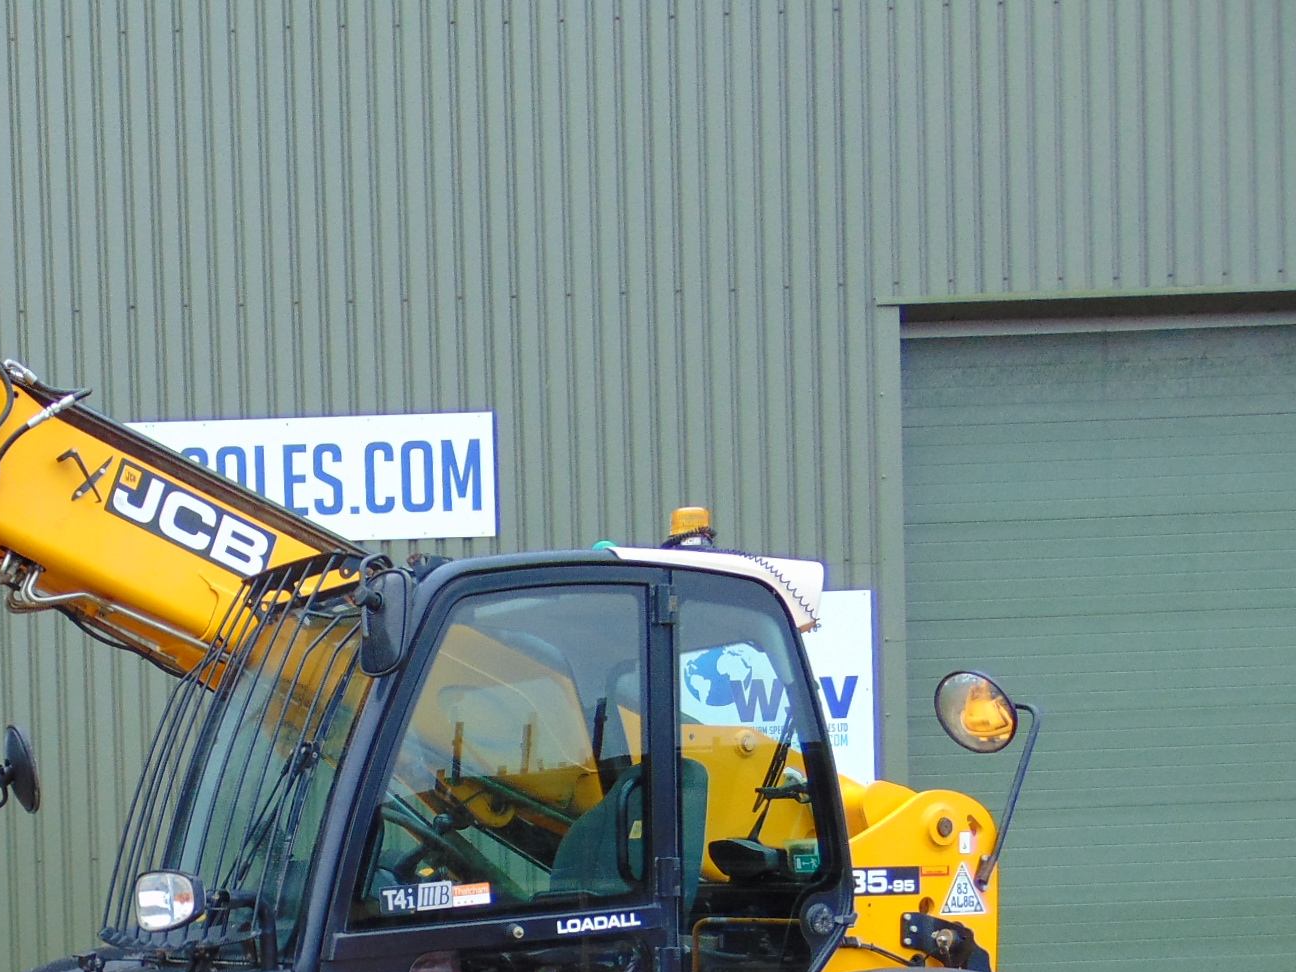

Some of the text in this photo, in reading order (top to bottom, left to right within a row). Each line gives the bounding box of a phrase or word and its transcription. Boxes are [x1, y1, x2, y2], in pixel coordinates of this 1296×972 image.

[181, 438, 483, 517] LES.COM
[112, 477, 269, 577] JCB
[729, 675, 859, 723] WV
[382, 887, 415, 911] T4i
[454, 885, 488, 897] Thatcham
[956, 882, 968, 895] 83
[556, 912, 642, 935] LOADALL
